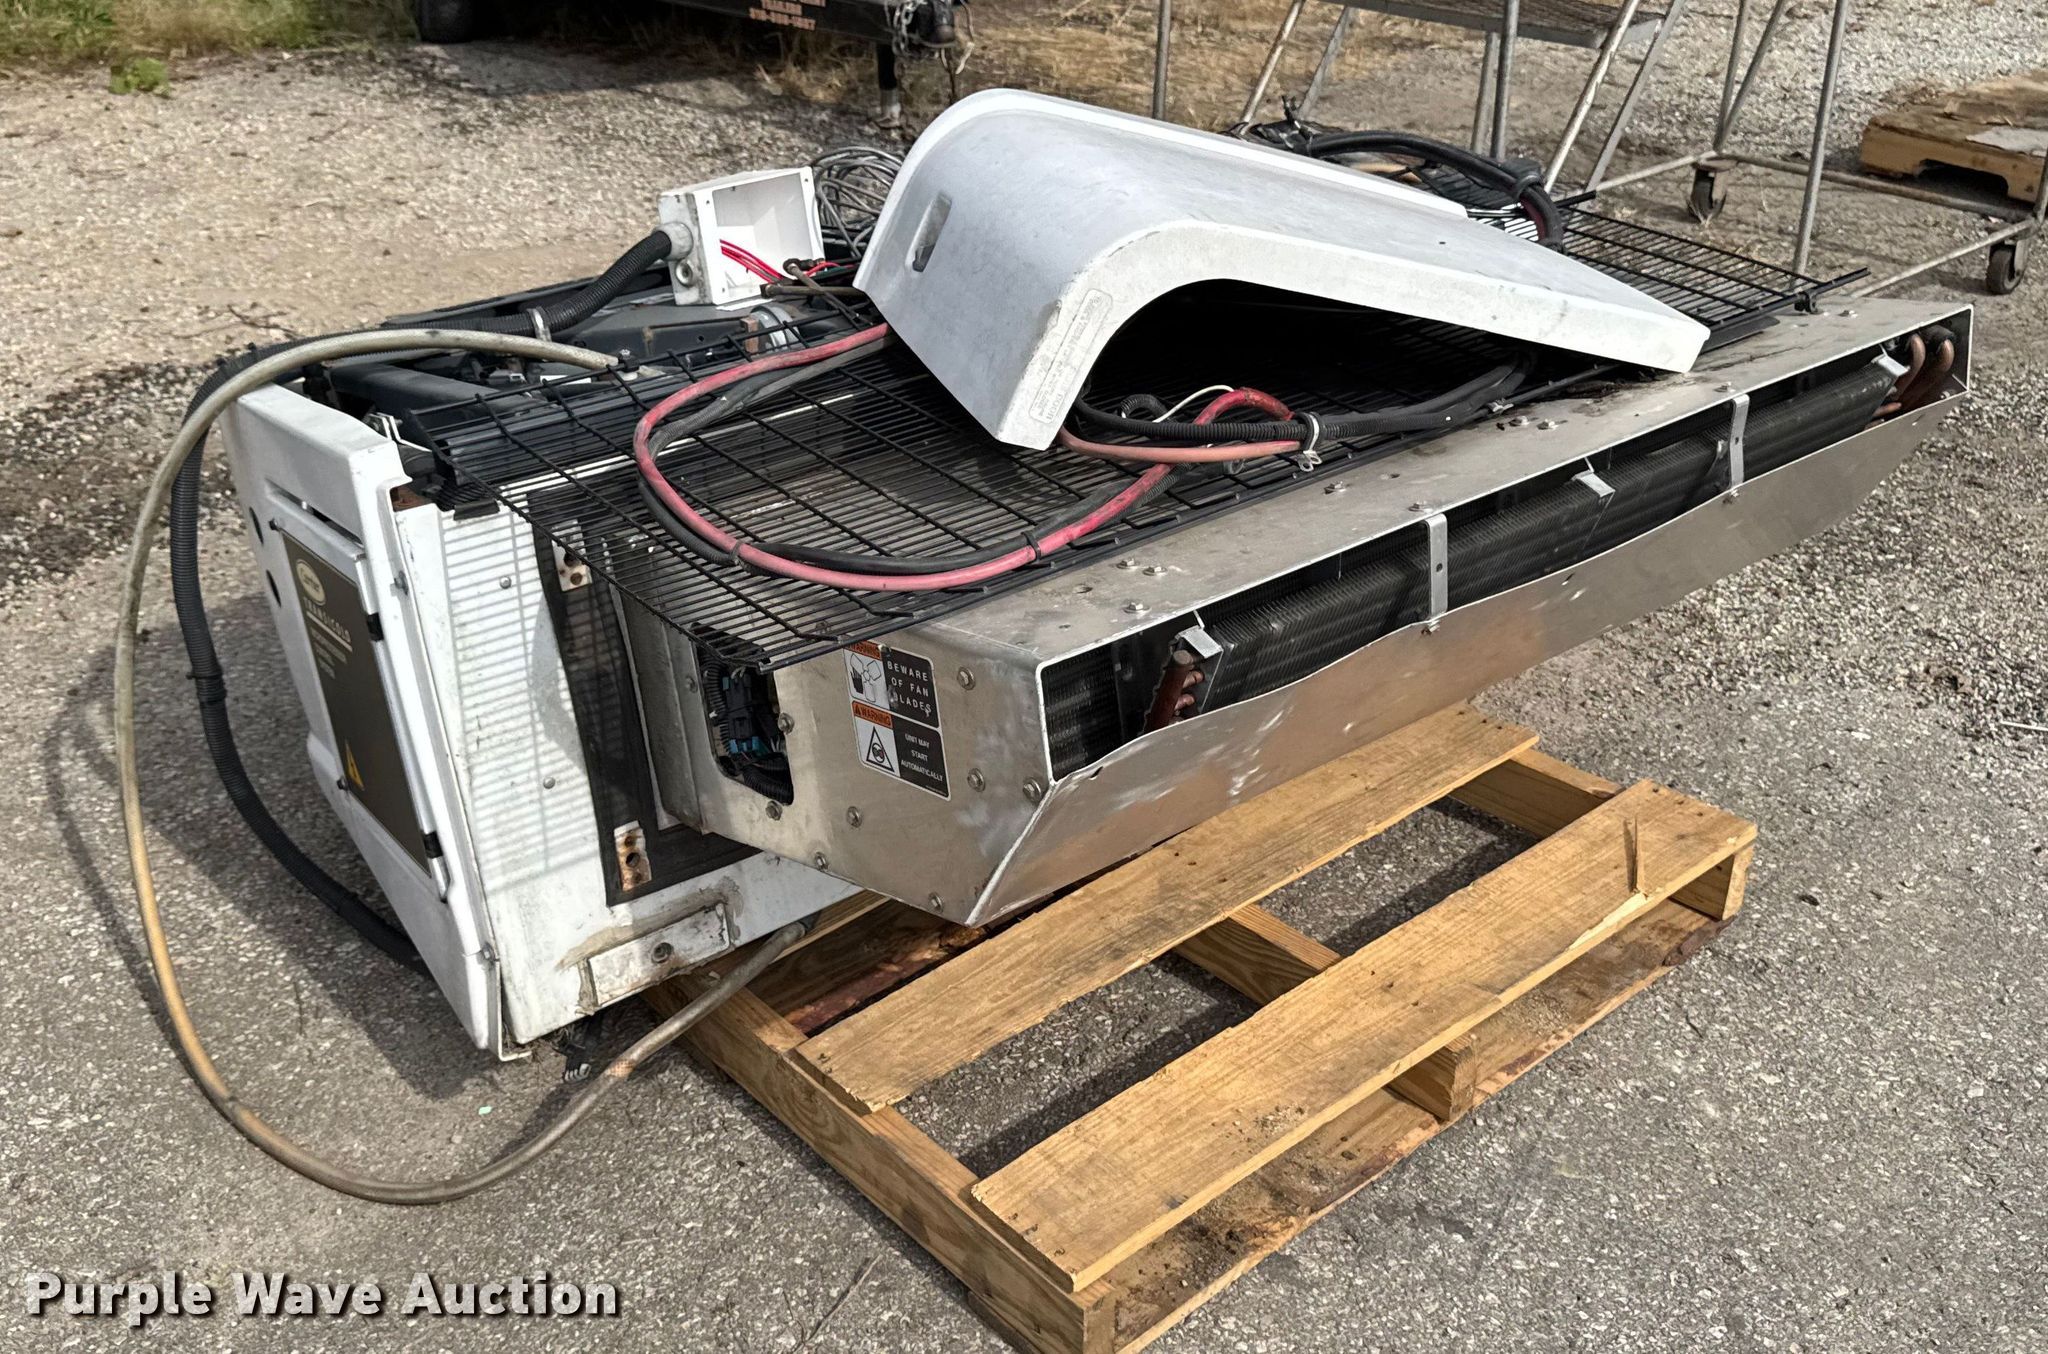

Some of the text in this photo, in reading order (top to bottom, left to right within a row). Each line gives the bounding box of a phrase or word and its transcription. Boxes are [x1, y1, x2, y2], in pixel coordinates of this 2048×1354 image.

[887, 661, 928, 681] BEWARE
[891, 677, 929, 697] OF FAN
[911, 749, 929, 763] START
[900, 759, 944, 782] AUTOMATICALLY
